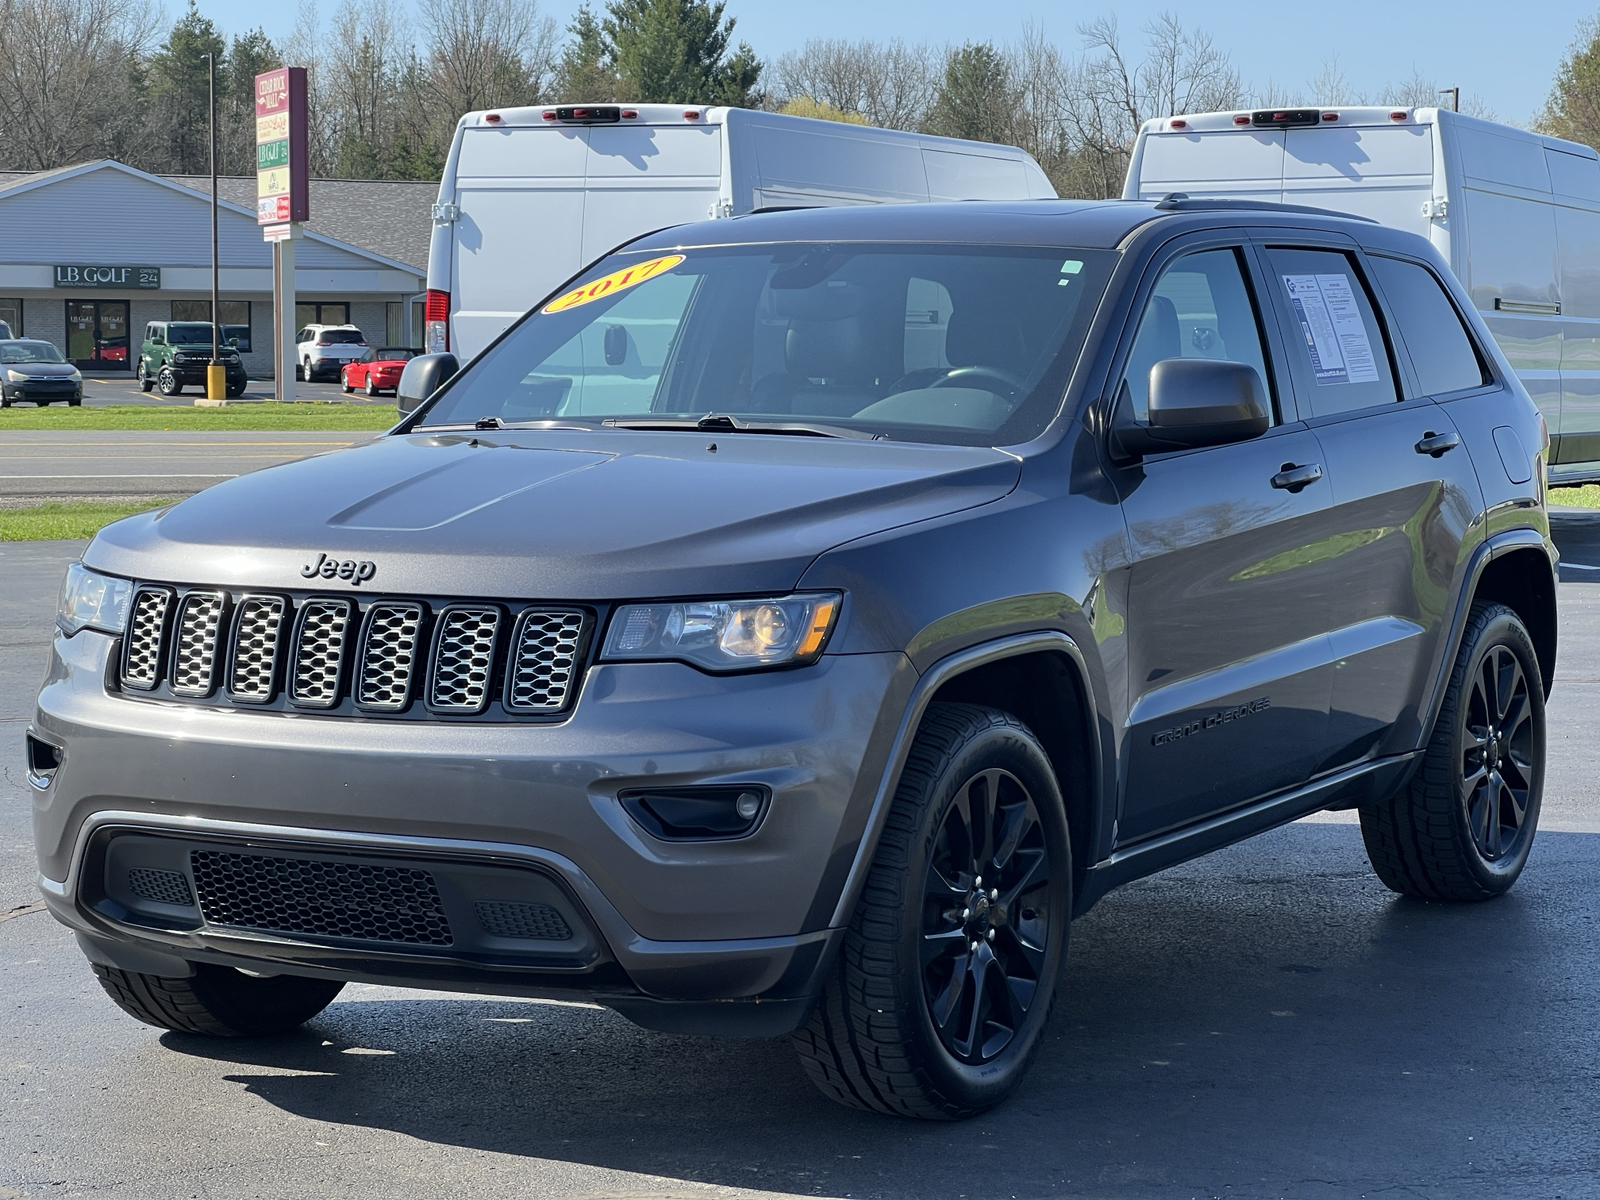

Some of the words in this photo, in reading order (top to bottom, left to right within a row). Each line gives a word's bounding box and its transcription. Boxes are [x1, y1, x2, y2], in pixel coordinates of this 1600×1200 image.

[273, 76, 286, 92] ROCK
[258, 145, 266, 162] LB
[266, 143, 280, 161] GOLF
[57, 266, 79, 281] LB
[84, 267, 132, 282] GOLF
[139, 273, 158, 282] 24
[561, 259, 665, 309] 2017
[300, 552, 377, 586] Jeep
[1151, 719, 1201, 747] GRAND
[1202, 695, 1272, 730] CHEROKEE
[1003, 735, 1028, 753] T/A
